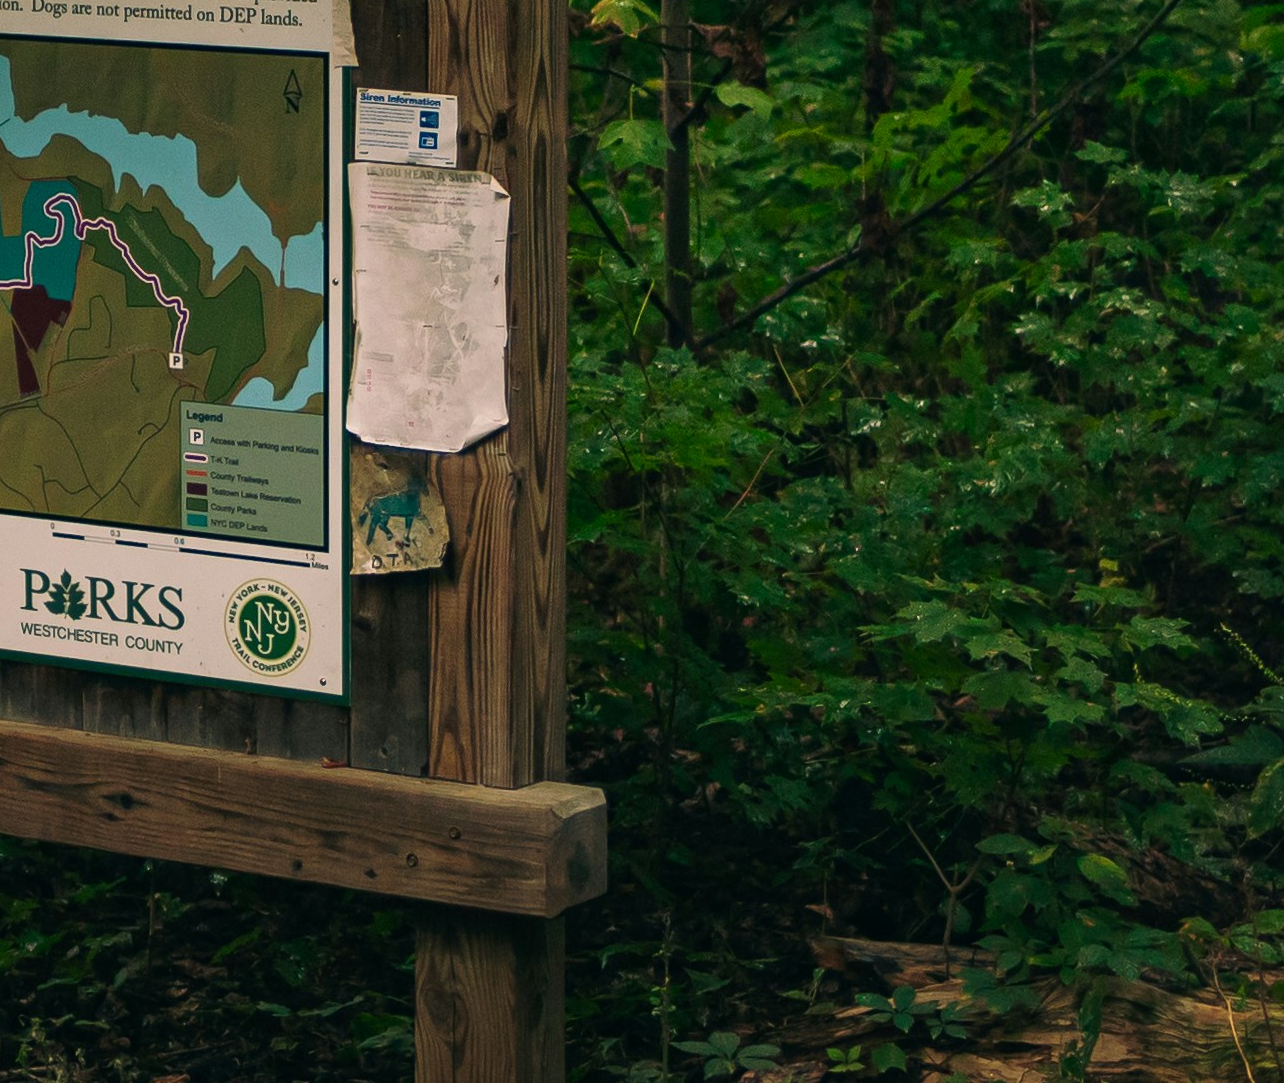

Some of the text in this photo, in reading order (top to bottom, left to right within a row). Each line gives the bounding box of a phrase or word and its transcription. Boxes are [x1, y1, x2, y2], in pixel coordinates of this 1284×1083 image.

[286, 97, 299, 113] N
[360, 92, 441, 106] Siren Information
[380, 168, 401, 177] YOU
[404, 169, 434, 180] HEAR
[186, 410, 223, 422] Legend
[211, 437, 235, 446] Access
[237, 438, 250, 447] with
[253, 441, 279, 452] Parking
[281, 444, 294, 452] and
[296, 446, 319, 454] Kiosks
[211, 456, 239, 465] T-K Trail
[211, 472, 235, 482] County
[211, 488, 239, 497] Teatown
[211, 503, 235, 514] County
[229, 520, 245, 528] DEP
[247, 523, 267, 532] Lands
[229, 584, 306, 632] NEW YORK NEW JERSEY
[21, 622, 183, 654] WESTCHESTER COUNTY
[232, 638, 304, 671] TRAIL CONFERENCE
